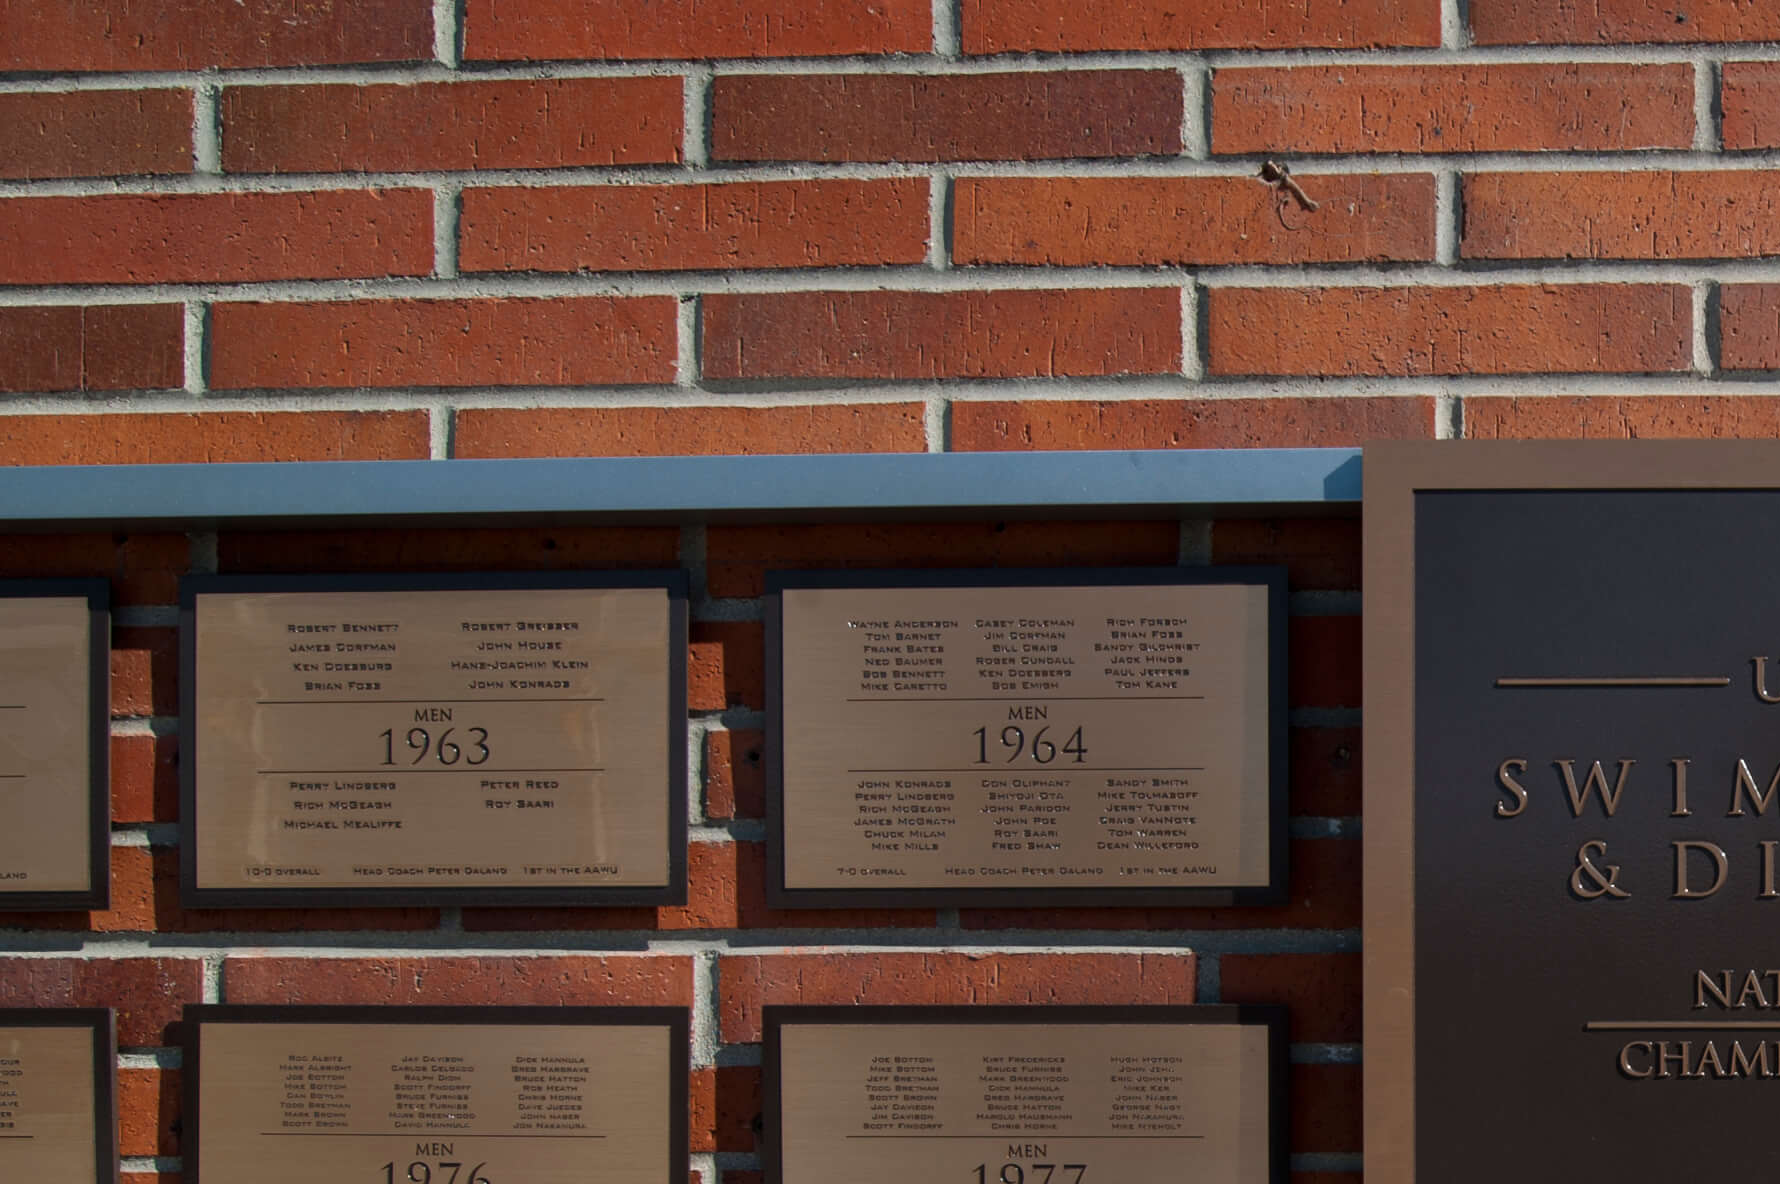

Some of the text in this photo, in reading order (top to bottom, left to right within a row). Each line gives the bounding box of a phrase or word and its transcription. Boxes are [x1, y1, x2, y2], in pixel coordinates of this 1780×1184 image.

[414, 707, 453, 723] MEN
[1008, 705, 1048, 721] MEN
[380, 727, 490, 766] 1963
[973, 725, 1089, 765] 1964
[1569, 838, 1632, 900] &
[415, 1142, 454, 1157] MEN
[1007, 1143, 1047, 1159] MEN
